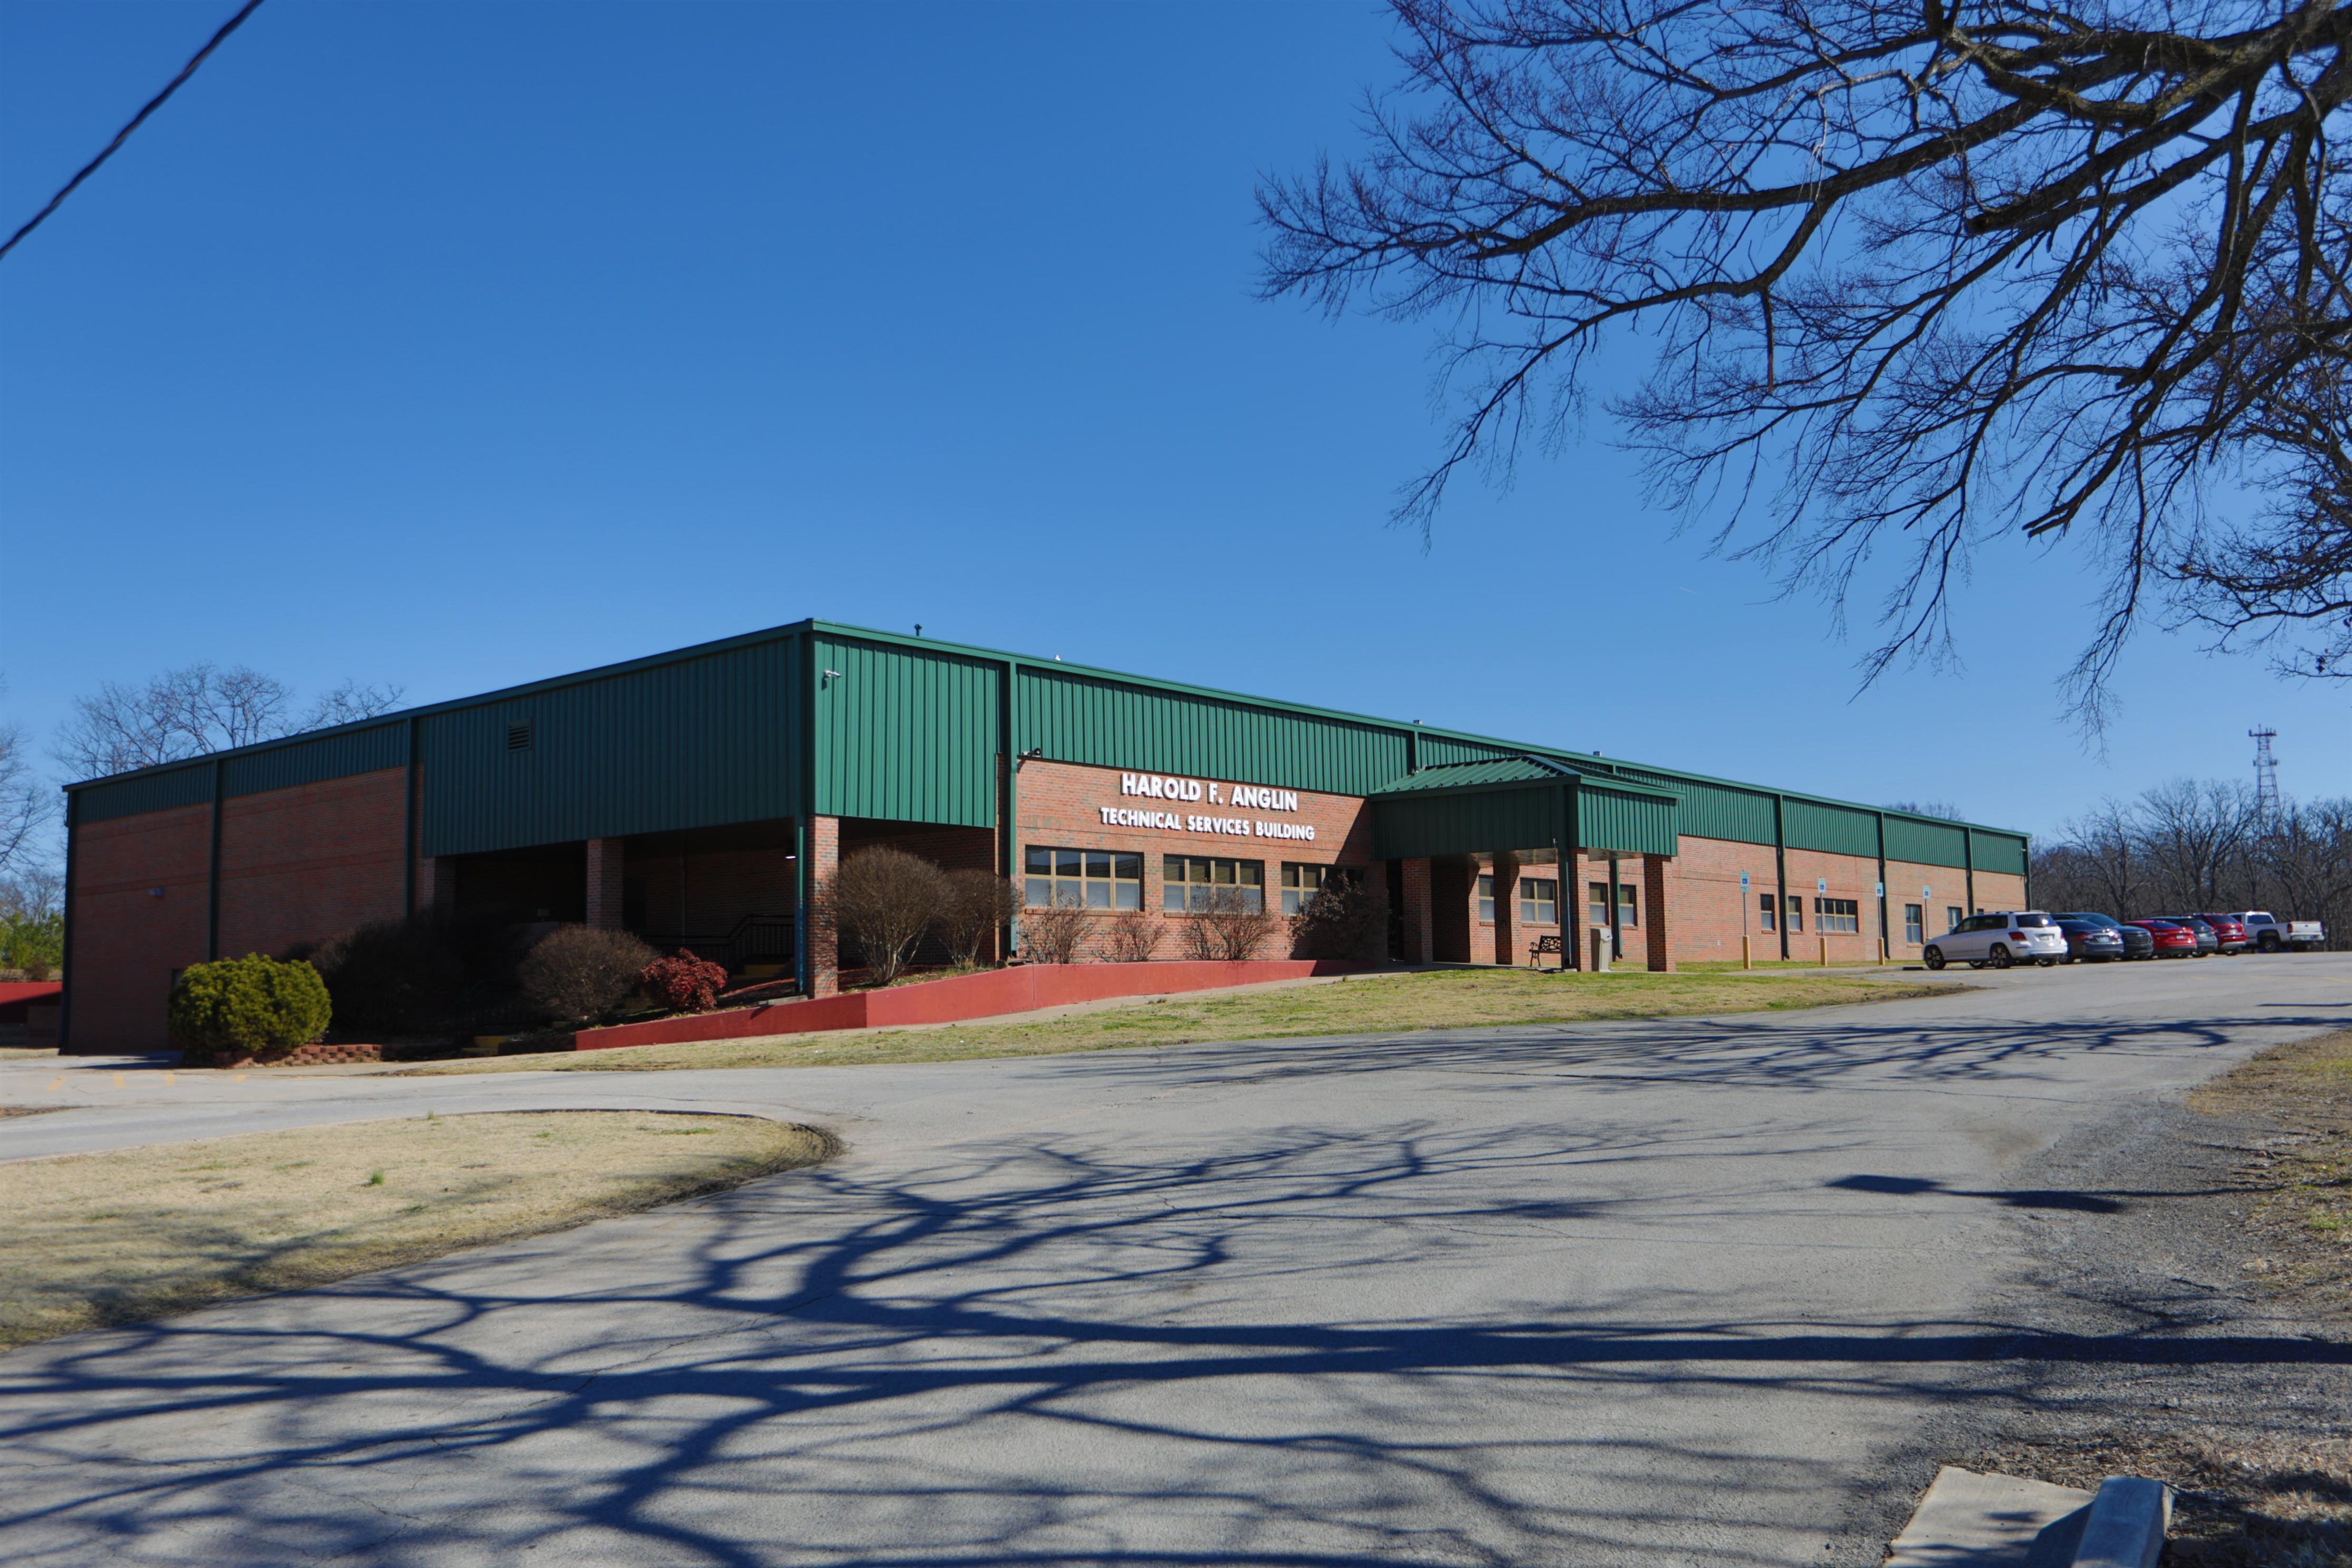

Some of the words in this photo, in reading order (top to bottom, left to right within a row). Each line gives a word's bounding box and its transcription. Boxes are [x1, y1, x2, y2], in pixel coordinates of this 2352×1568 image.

[1121, 772, 1201, 801] HAROLD
[1208, 782, 1224, 804] F.
[1231, 785, 1297, 811] ANGLIN
[1101, 807, 1182, 830] TECHNICAL
[1187, 815, 1250, 835] SERVICES
[1255, 821, 1315, 840] BUILDING
